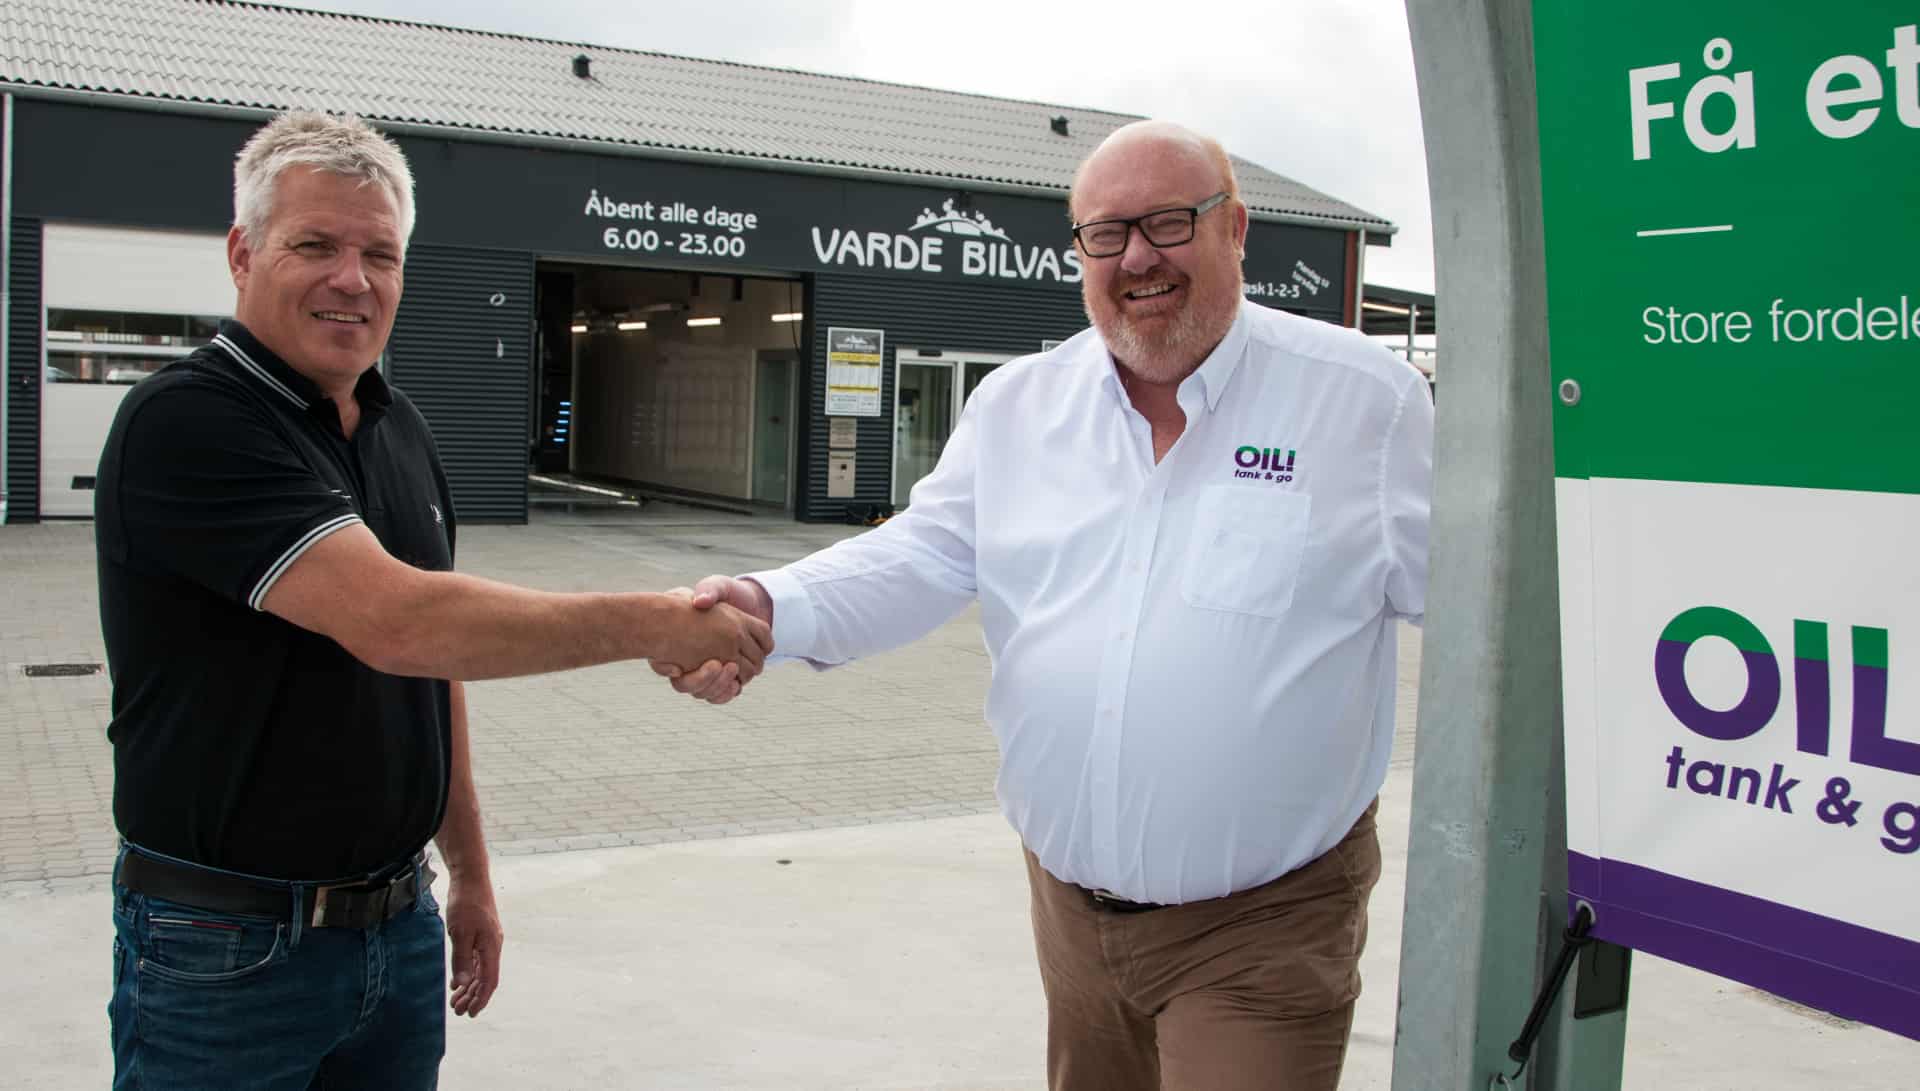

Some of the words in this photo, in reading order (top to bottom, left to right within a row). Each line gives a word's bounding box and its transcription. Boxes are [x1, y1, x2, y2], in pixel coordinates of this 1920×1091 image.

[1628, 37, 1756, 161] Få
[1805, 24, 1920, 139] et
[584, 189, 655, 221] Åbent
[659, 202, 699, 225] alle
[703, 206, 758, 233] dage
[603, 228, 659, 251] 6.00
[679, 233, 746, 257] 23.00
[811, 226, 943, 273] VARDE
[962, 240, 1083, 283] BILVAS
[1642, 306, 1752, 345] Store
[1768, 295, 1920, 342] fordel
[1234, 468, 1261, 480] tank
[1264, 472, 1273, 480] &
[1276, 475, 1292, 483] go
[1654, 606, 1920, 776] OIL
[1666, 745, 1801, 814] tank
[1816, 776, 1863, 827] &
